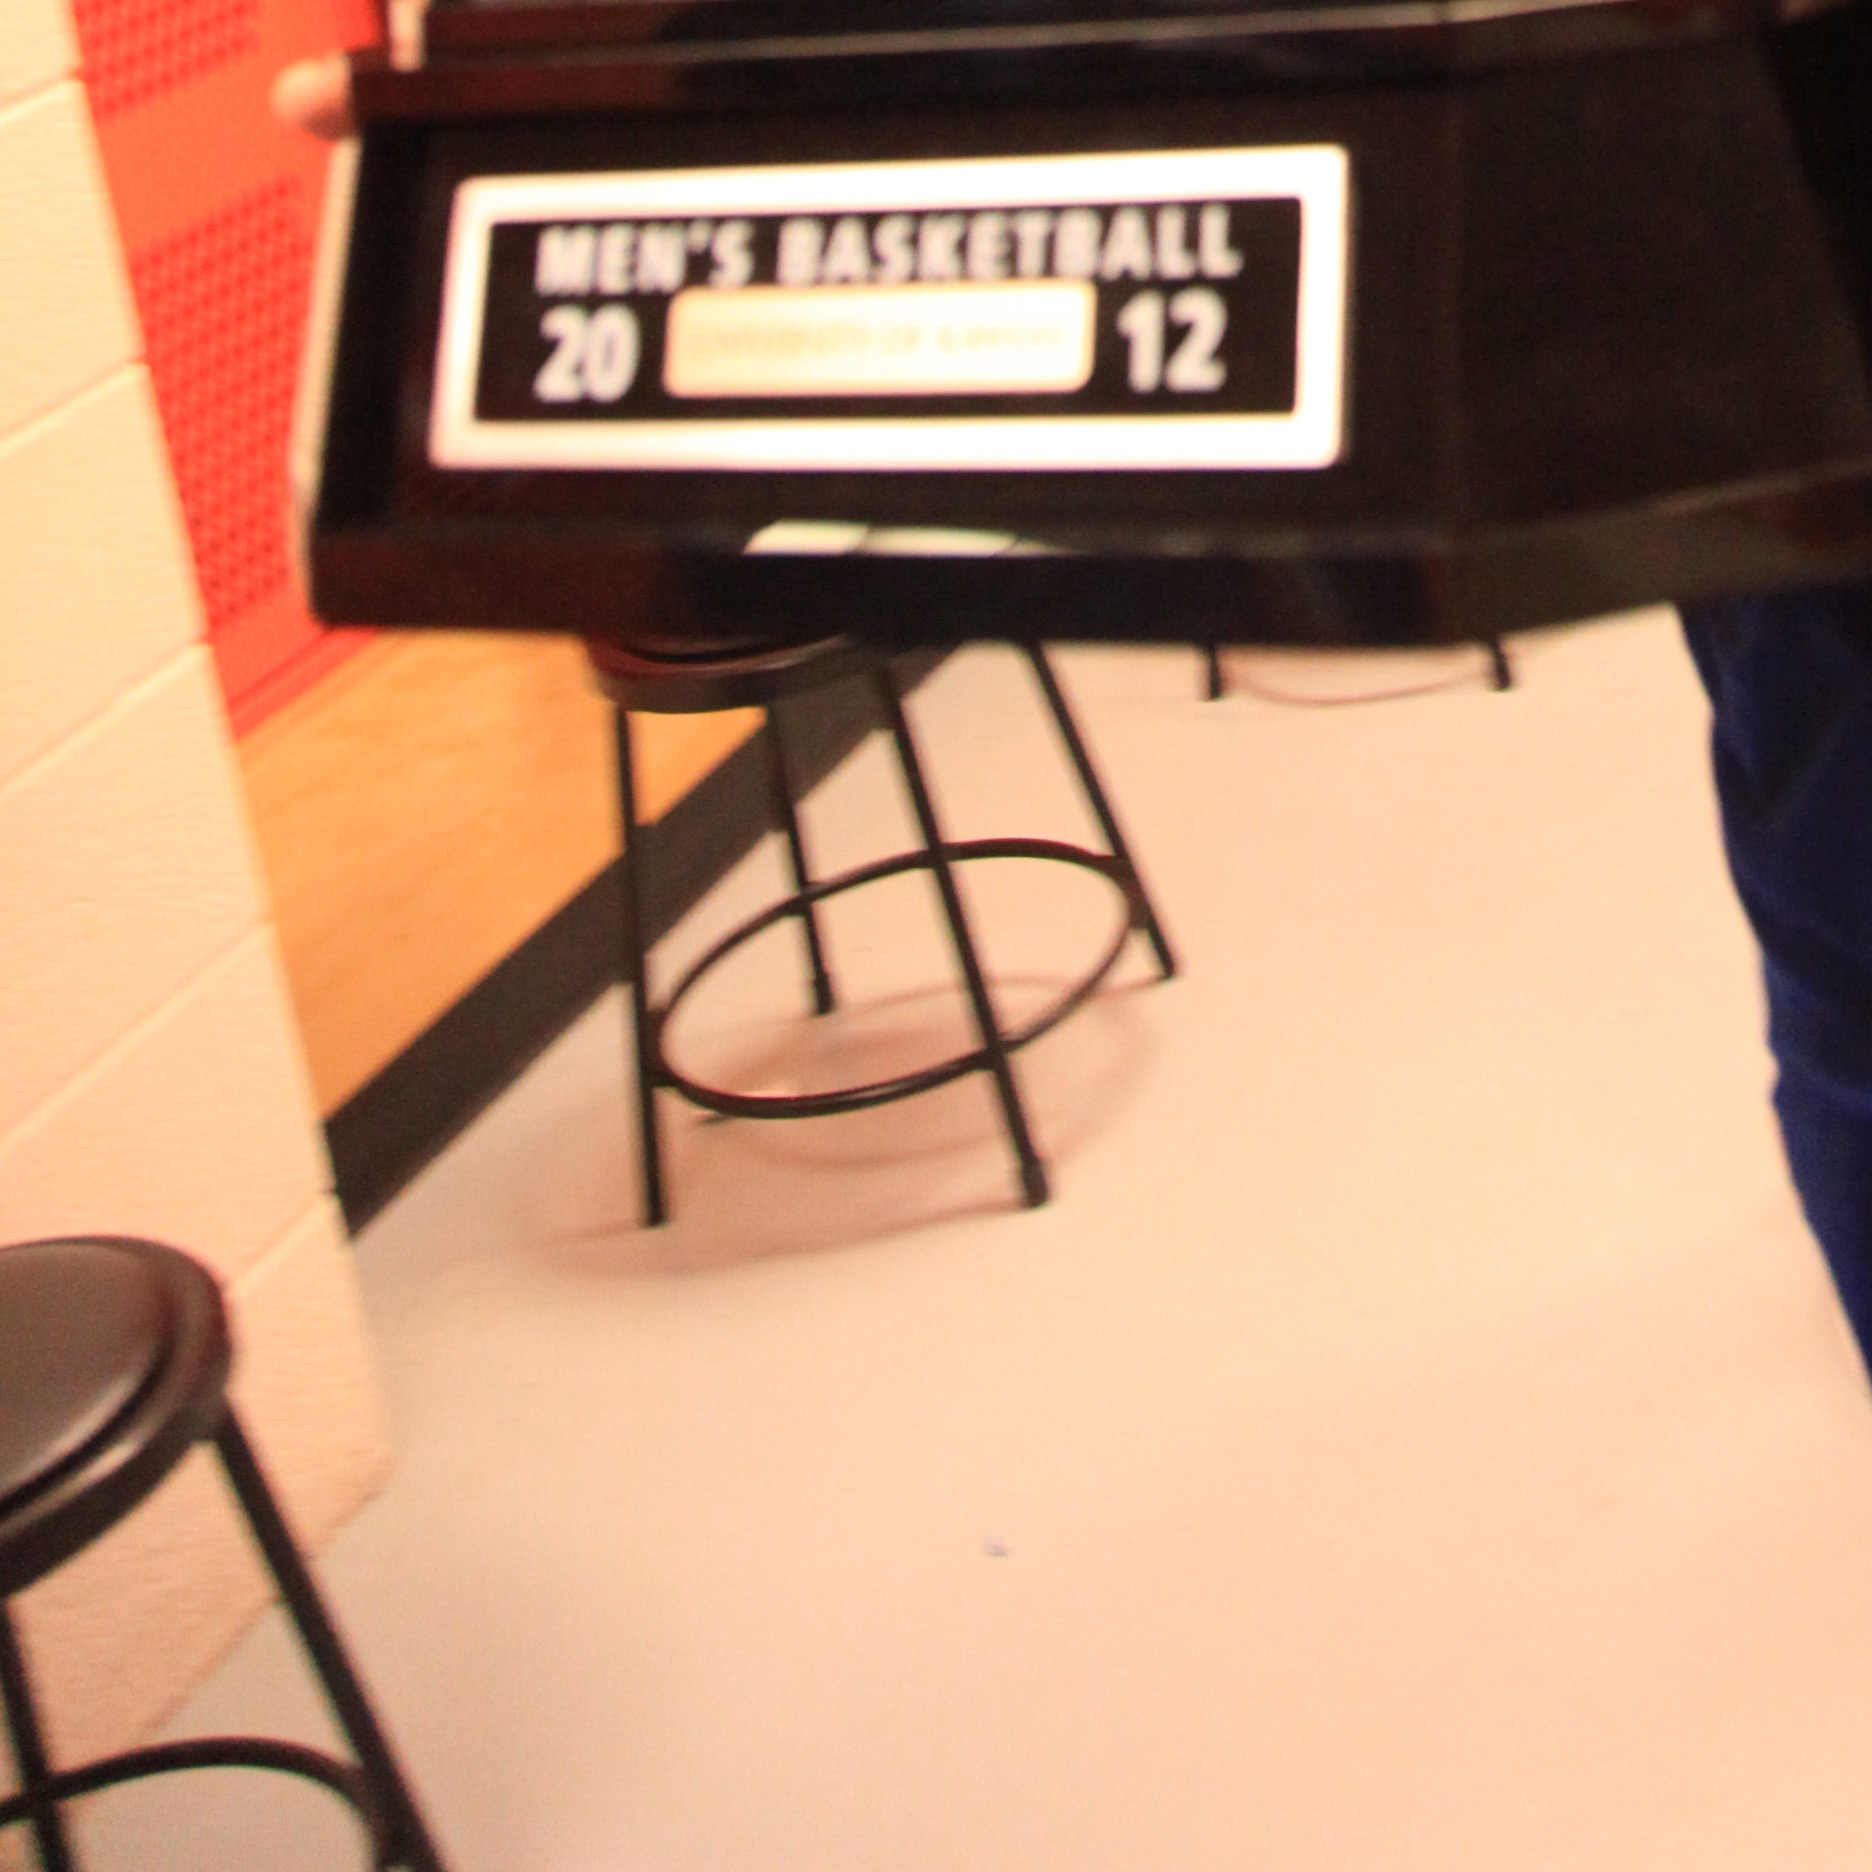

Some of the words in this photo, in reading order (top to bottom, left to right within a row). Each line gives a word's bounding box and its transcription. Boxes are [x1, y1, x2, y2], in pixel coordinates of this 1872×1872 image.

[534, 219, 756, 297] MEN'S
[776, 203, 1243, 290] BASKETBALL
[533, 303, 639, 404] 20
[1117, 285, 1227, 394] 12
